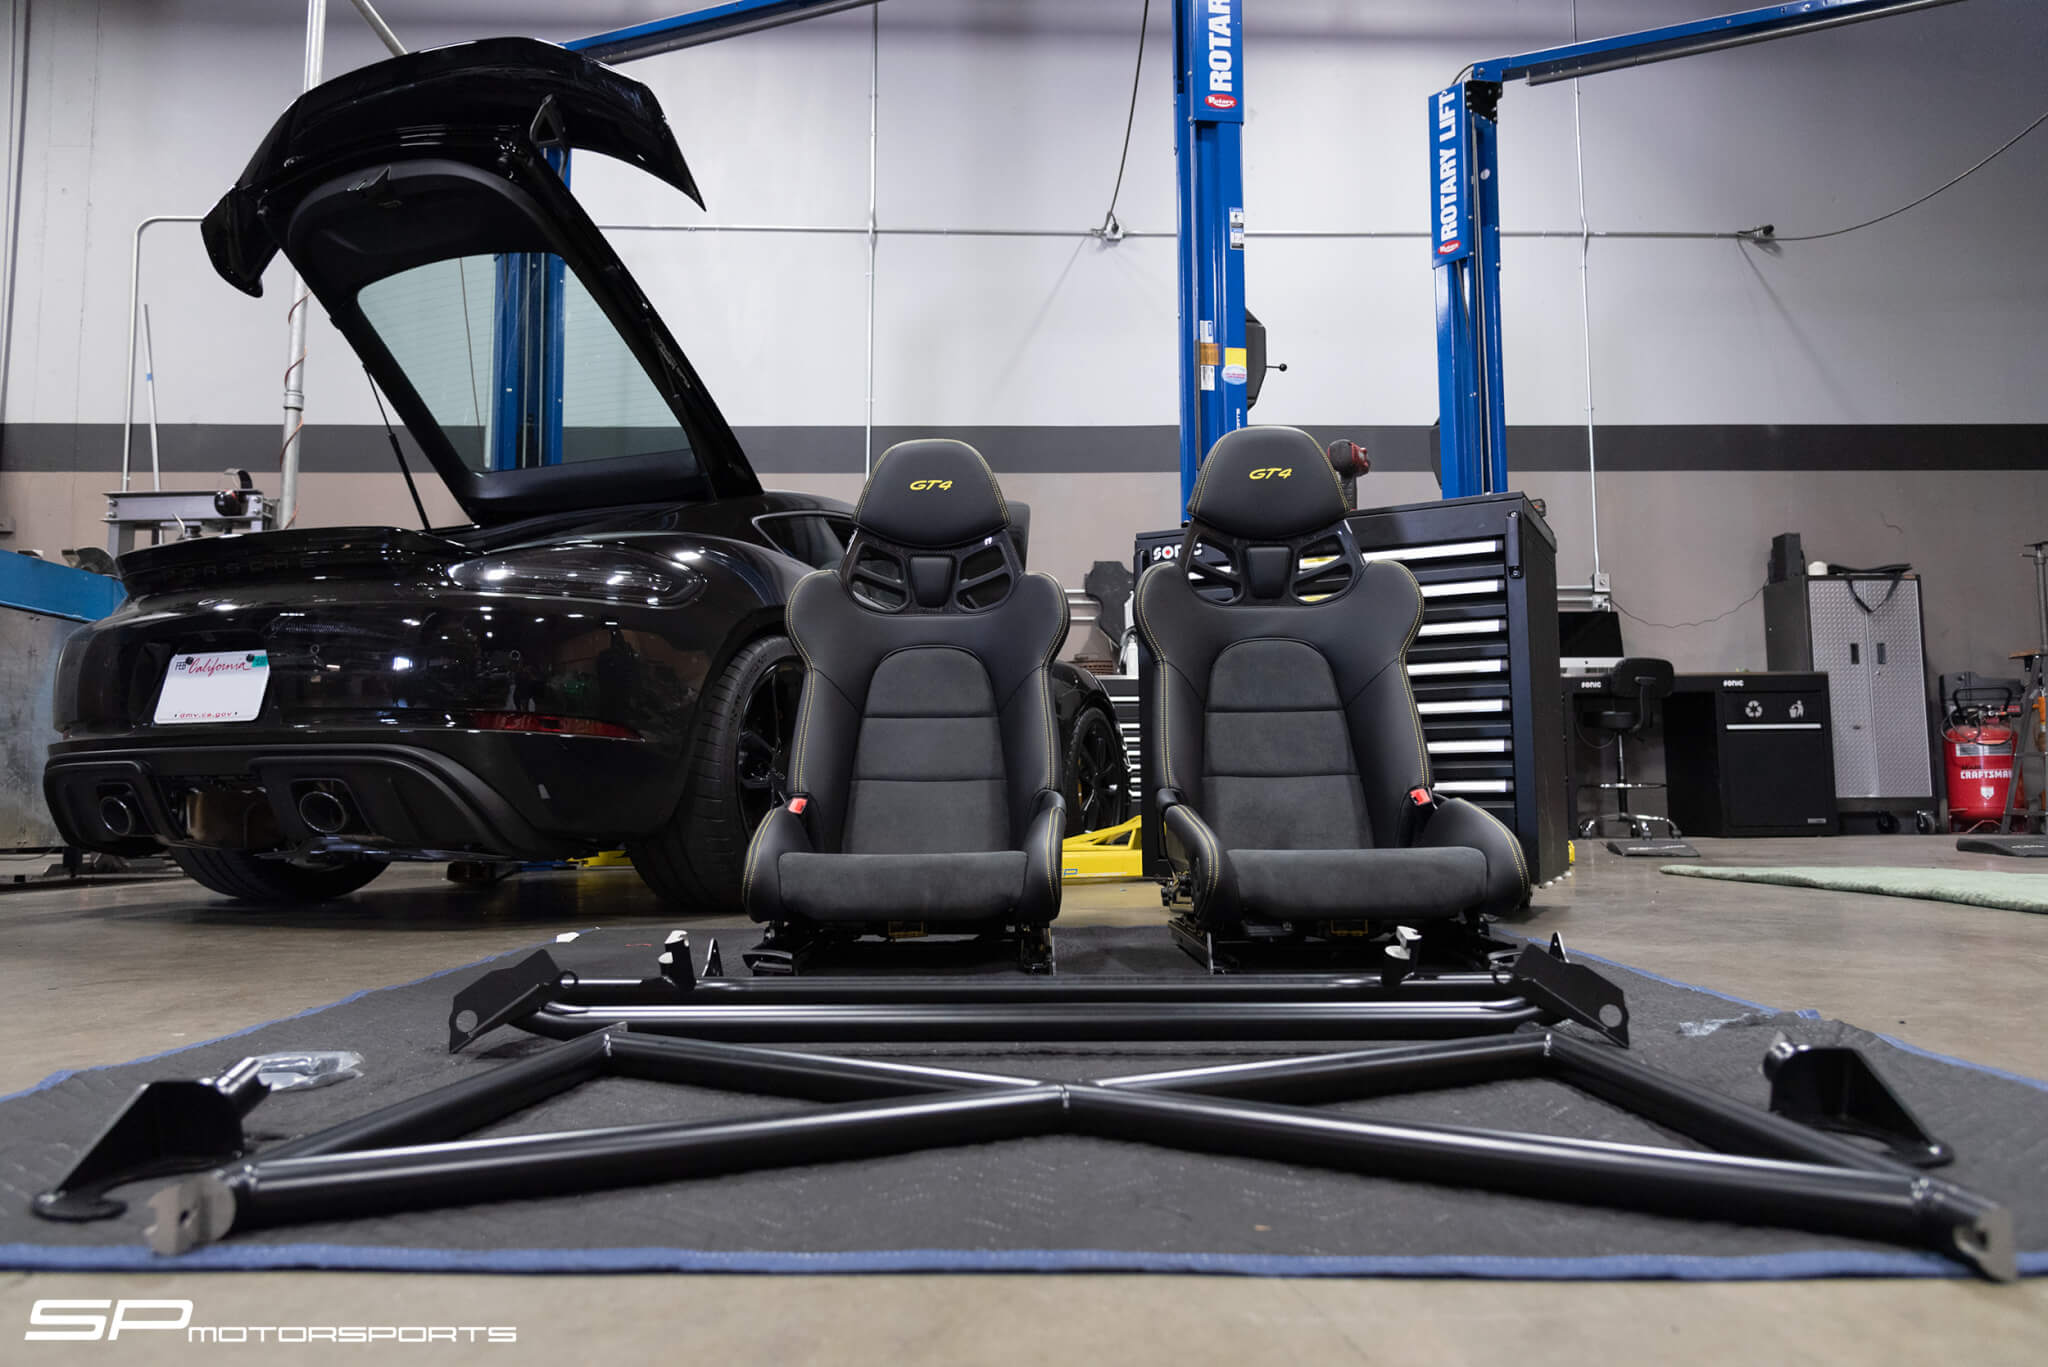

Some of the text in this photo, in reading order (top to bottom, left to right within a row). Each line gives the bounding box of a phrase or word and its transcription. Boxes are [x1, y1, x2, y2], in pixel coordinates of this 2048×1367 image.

[1438, 91, 1458, 242] ROTARY LIFT
[1248, 467, 1293, 480] GT4
[909, 479, 953, 491] GT4
[187, 656, 252, 678] California
